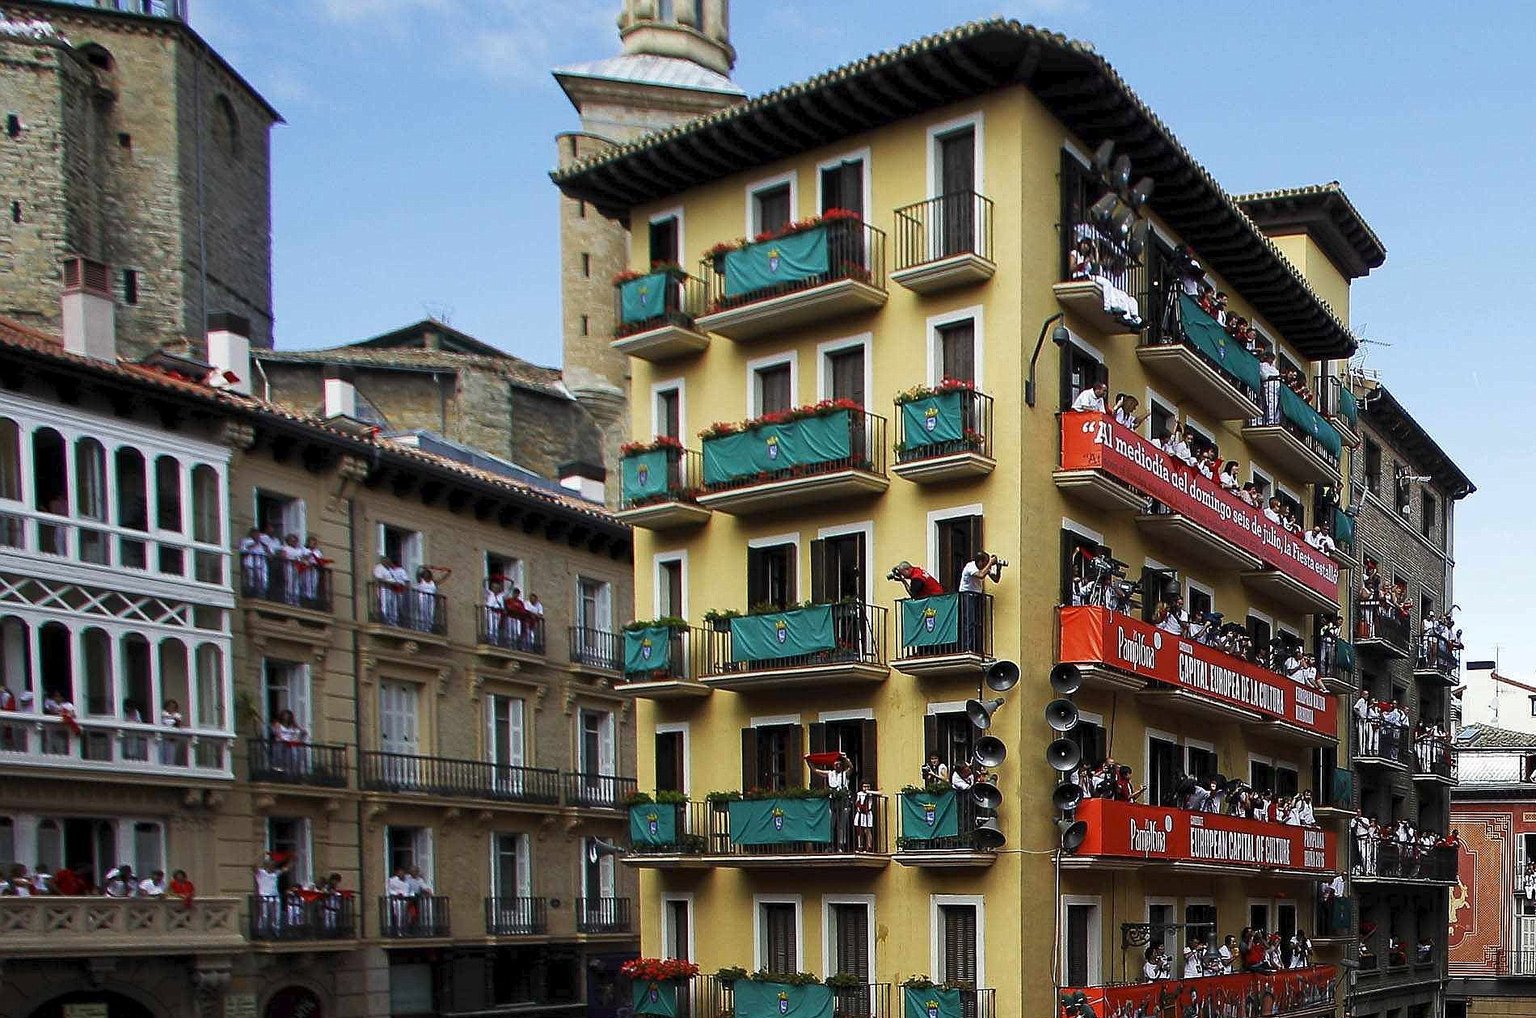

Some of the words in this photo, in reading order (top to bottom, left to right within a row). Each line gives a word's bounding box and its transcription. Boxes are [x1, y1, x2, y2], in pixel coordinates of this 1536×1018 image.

[1115, 438, 1169, 483] mediodía
[1171, 471, 1188, 494] del
[1189, 480, 1232, 520] domingo
[1232, 509, 1250, 531] seis
[1251, 515, 1262, 538] de
[1261, 523, 1284, 554] julio,
[1284, 534, 1292, 557] la
[1292, 541, 1315, 571] Fiesta
[1179, 653, 1209, 691] CAPITAL
[1210, 664, 1241, 702] EUROPEA
[1241, 674, 1250, 704] DE
[1250, 678, 1259, 707] LA
[1259, 681, 1285, 716] CULTURA
[1190, 827, 1228, 860] EUROPEAN
[1228, 831, 1255, 862] CAPITAL
[1256, 835, 1265, 863] OF
[1265, 836, 1291, 865] CULTURE
